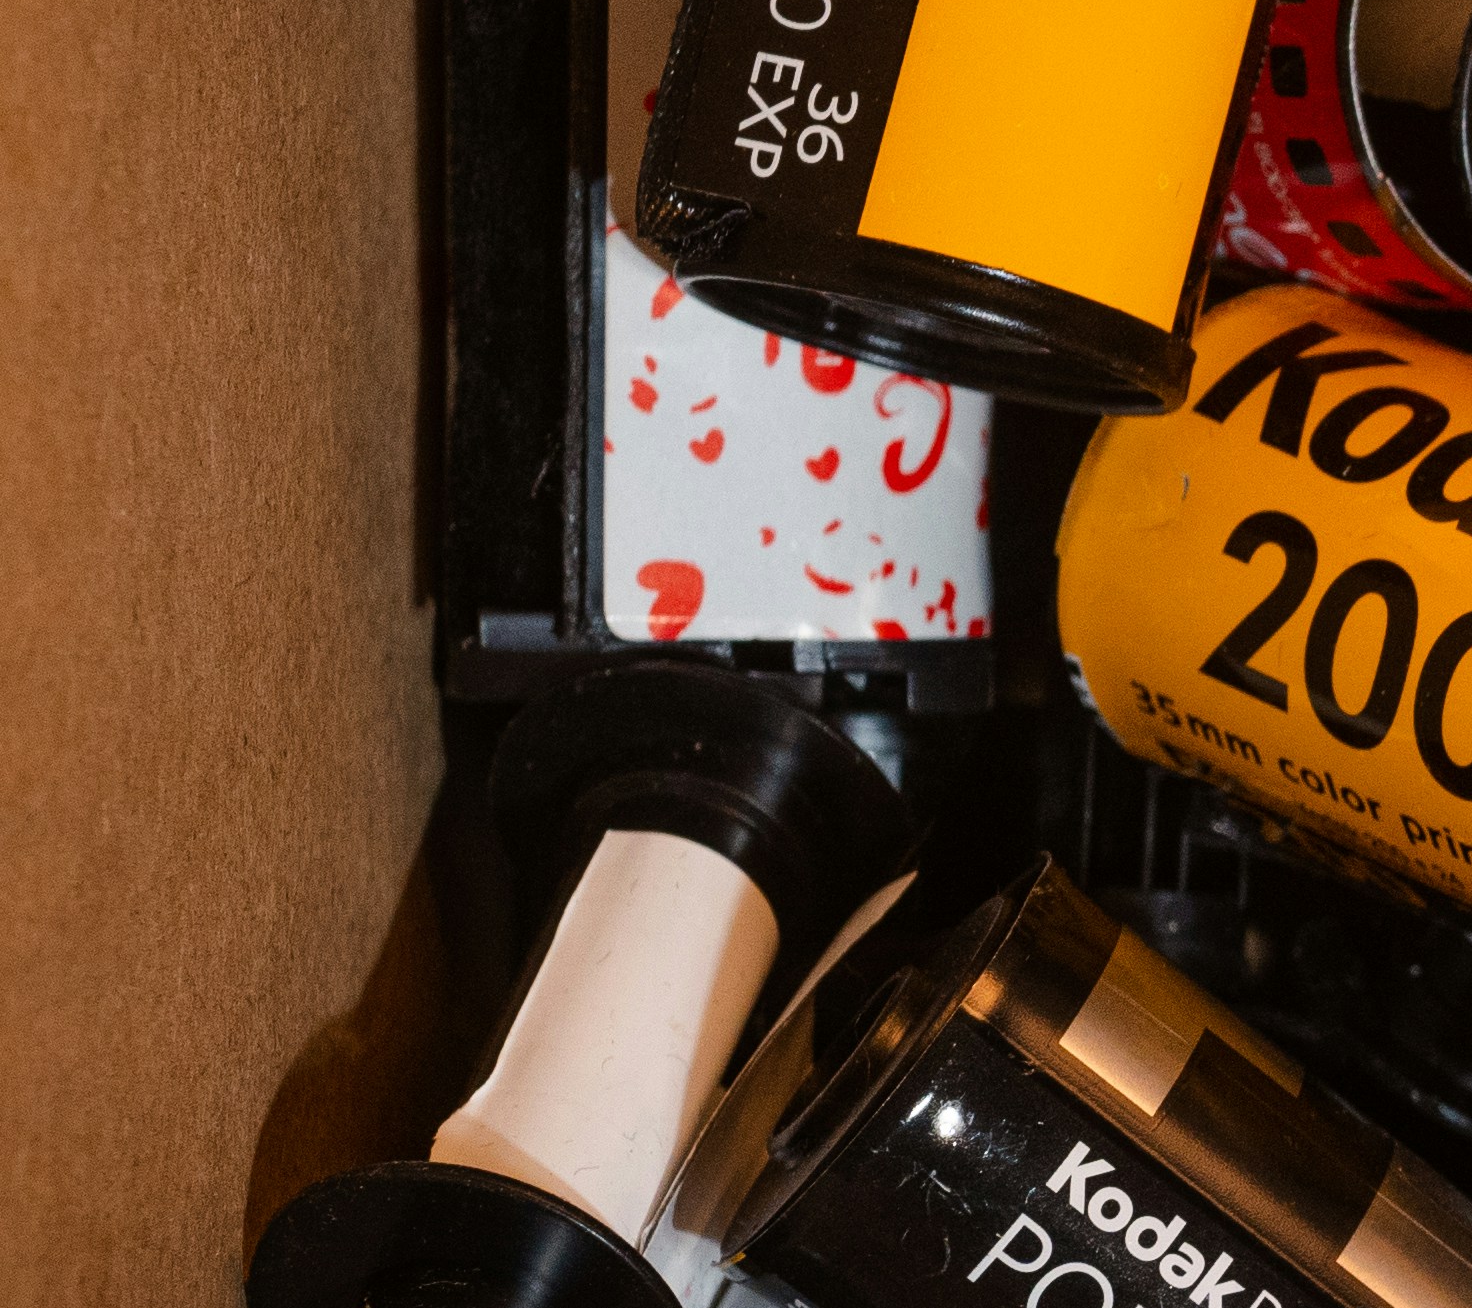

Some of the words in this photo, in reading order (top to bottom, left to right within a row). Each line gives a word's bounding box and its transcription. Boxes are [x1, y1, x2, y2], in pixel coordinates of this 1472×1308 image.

[733, 48, 807, 180] EXP
[796, 81, 859, 166] 36
[1132, 678, 1263, 766] 35mm
[1277, 749, 1383, 822] color
